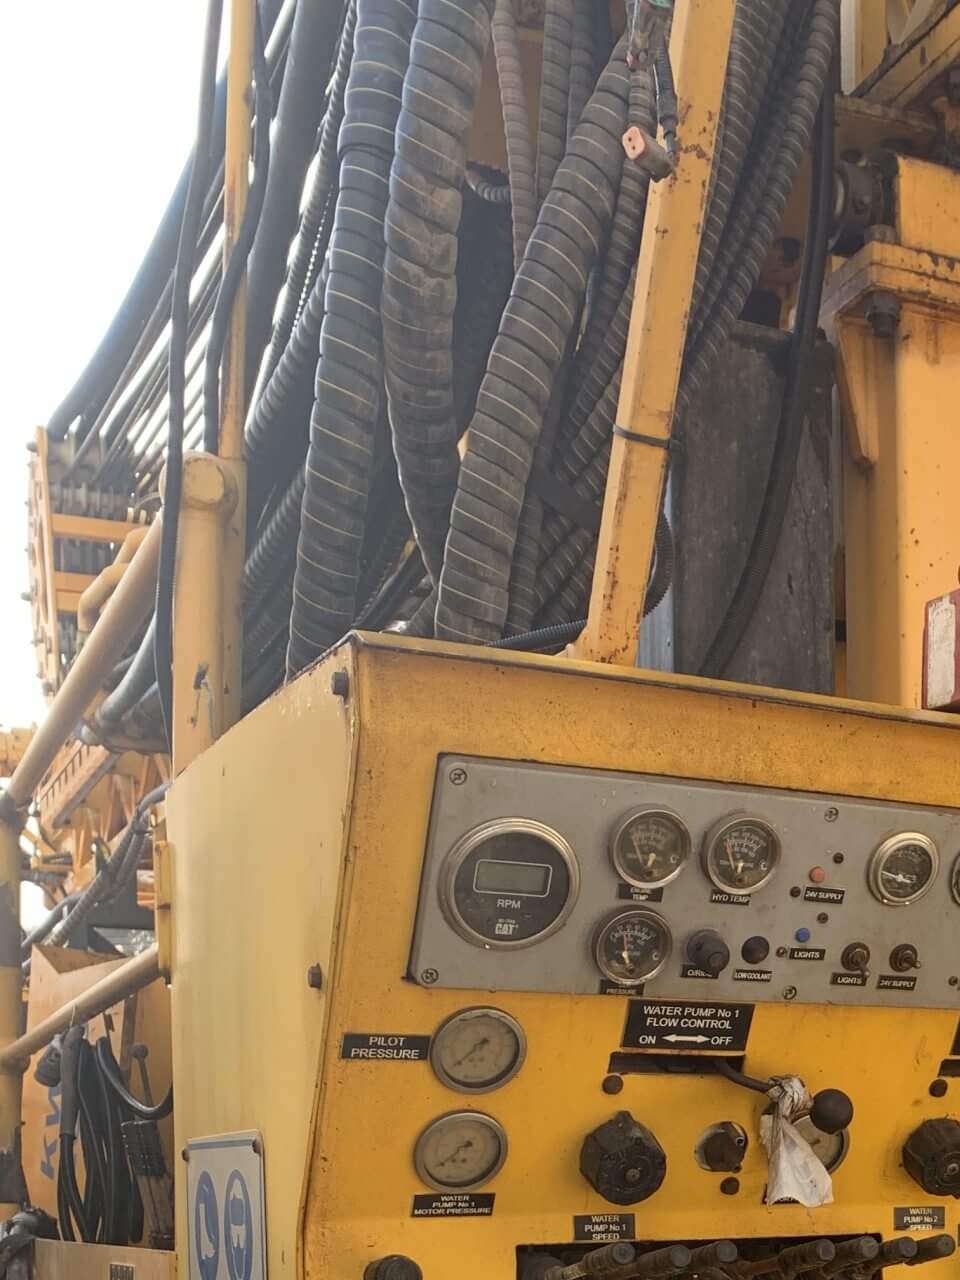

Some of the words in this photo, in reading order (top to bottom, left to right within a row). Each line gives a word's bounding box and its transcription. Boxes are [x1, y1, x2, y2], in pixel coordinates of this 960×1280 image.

[730, 894, 750, 902] TEMP
[819, 892, 842, 900] SUPPLY
[496, 898, 520, 908] RPM
[496, 923, 513, 935] CAT
[747, 972, 771, 980] COOLANT
[837, 976, 862, 984] LIGHTS
[892, 980, 914, 988] SUPPLY
[644, 1006, 682, 1016] WATER
[684, 1007, 716, 1016] PUMP
[718, 1008, 732, 1018] No
[735, 1010, 740, 1018] 1
[646, 1017, 679, 1027] FLOW
[680, 1018, 732, 1029] CONTROL
[368, 1036, 407, 1046] PILOT
[640, 1035, 656, 1044] ON
[711, 1036, 733, 1045] OFF
[350, 1048, 420, 1059] PRESSURE
[592, 1215, 620, 1223] WATER
[584, 1224, 608, 1232] PUMP
[610, 1224, 620, 1232] No
[592, 1233, 620, 1241] SPEED
